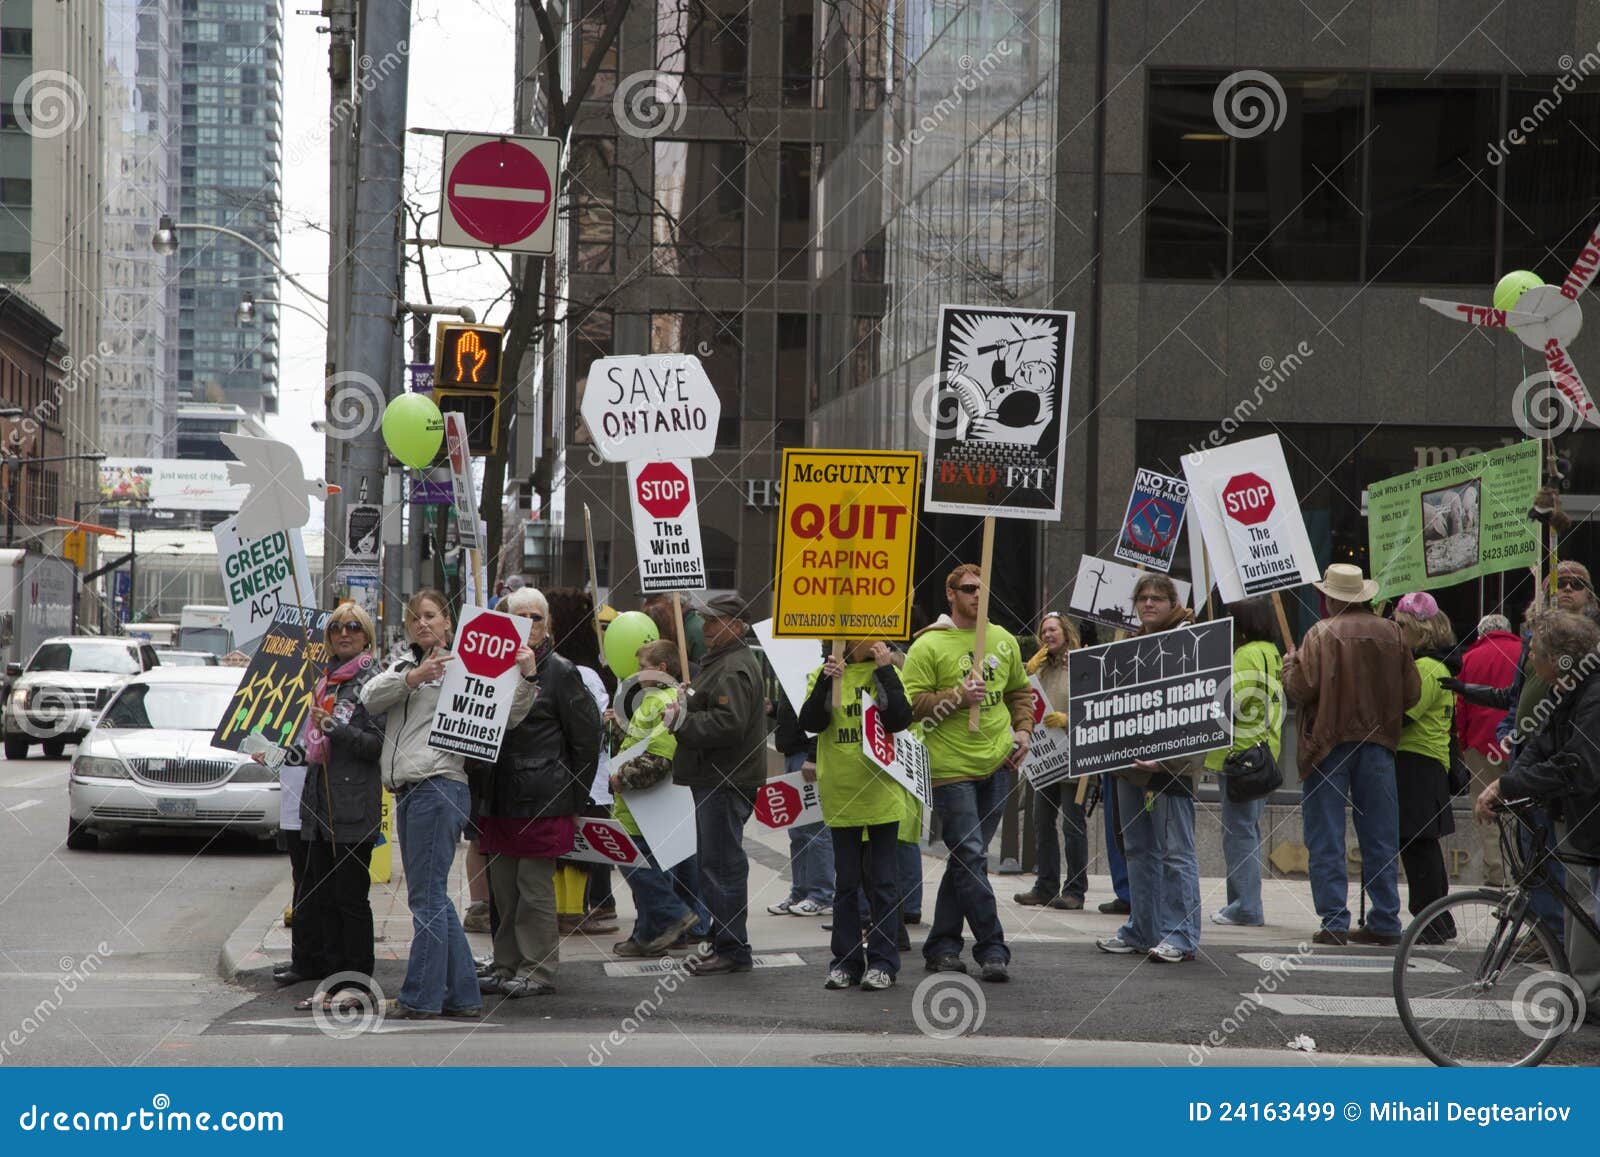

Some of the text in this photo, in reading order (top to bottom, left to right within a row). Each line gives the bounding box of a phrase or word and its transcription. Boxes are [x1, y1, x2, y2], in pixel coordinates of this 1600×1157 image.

[1456, 304, 1507, 328] KILL
[607, 367, 689, 405] SAVE
[602, 404, 707, 438] ONTARIO
[177, 472, 197, 480] west
[200, 471, 209, 480] of
[792, 463, 910, 485] McGUINTY
[939, 461, 1049, 490] BAD FIT
[1137, 471, 1189, 497] NO TO
[640, 480, 686, 503] STOP
[1135, 483, 1187, 505] WHITE PINES
[1226, 485, 1270, 513] STOP
[653, 520, 683, 538] The
[790, 503, 907, 541] QUIT
[1248, 526, 1271, 542] The
[225, 531, 286, 578] GREED
[650, 538, 690, 556] Wind
[802, 550, 889, 570] RAPING
[1248, 540, 1279, 560] Wind
[643, 557, 701, 575] Turbines!
[1241, 553, 1296, 579] Turbines!
[229, 556, 294, 605] ENERGY
[793, 577, 896, 597] ONTARIO
[250, 586, 283, 623] ACT
[783, 613, 900, 629] ONTARIO'S WESTCOAST
[262, 634, 300, 658] TURBINE
[463, 629, 516, 661] STOP
[464, 676, 496, 699] The
[1083, 677, 1217, 721] Turbines make
[452, 694, 498, 721] Wind
[437, 712, 502, 743] Turbines!
[874, 712, 887, 760] STOP
[1075, 700, 1226, 747] bad neighbours.
[896, 738, 905, 767] The
[905, 739, 915, 780] Wind
[1030, 739, 1056, 759] Wind
[1076, 729, 1226, 769] www.windconcernsontario.ca
[766, 786, 791, 825] STOP
[803, 784, 818, 810] The
[592, 825, 627, 860] STOP
